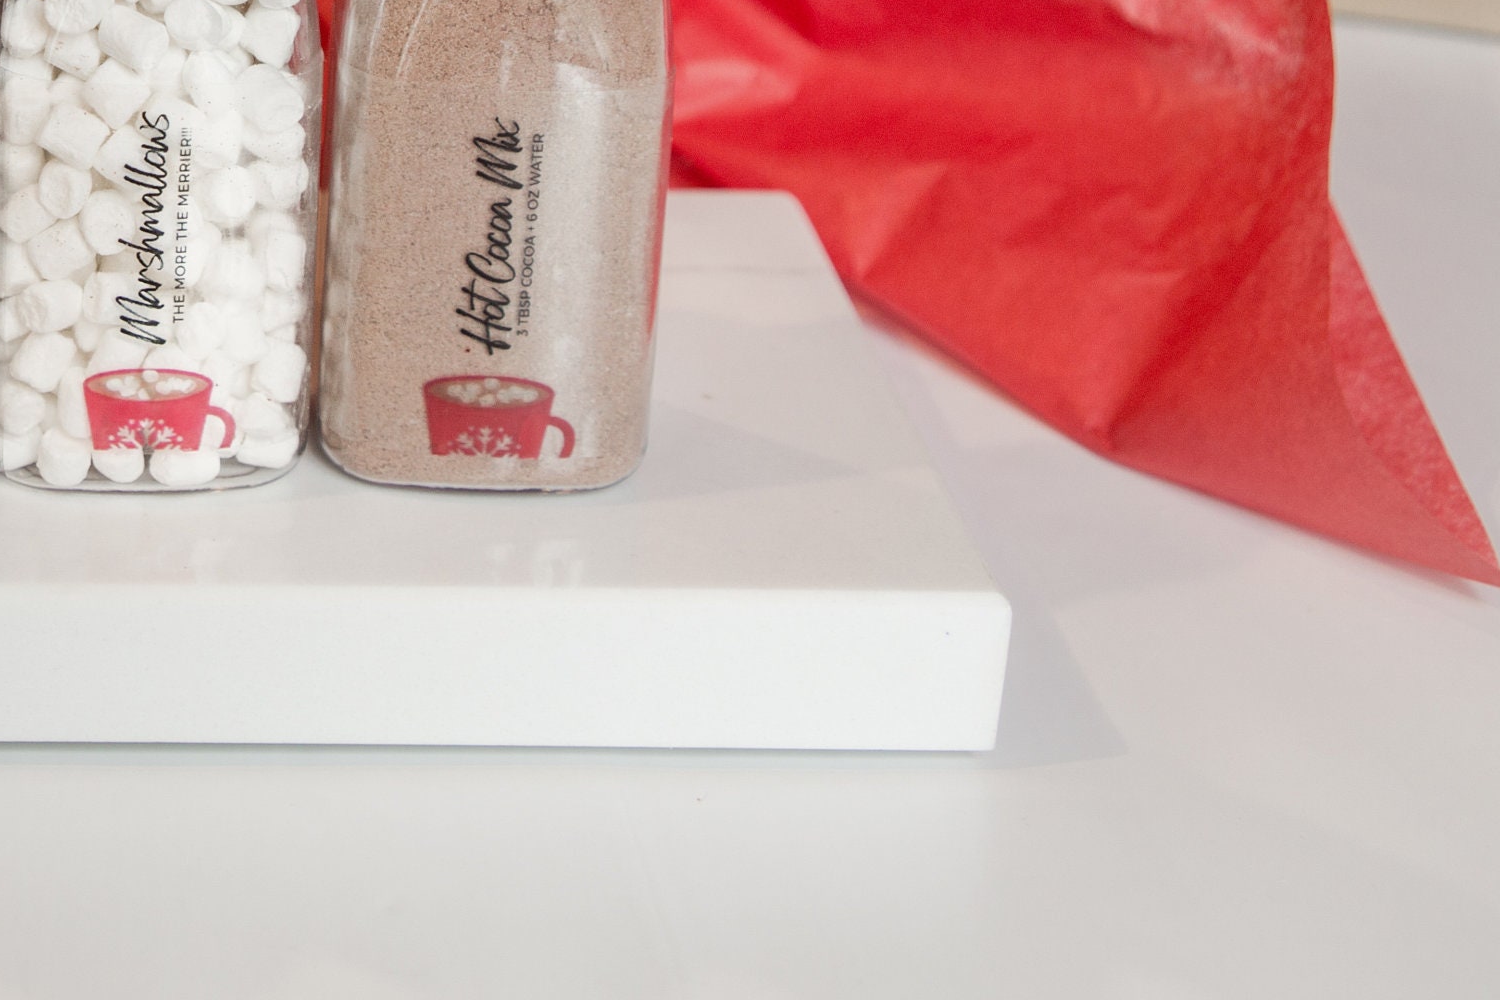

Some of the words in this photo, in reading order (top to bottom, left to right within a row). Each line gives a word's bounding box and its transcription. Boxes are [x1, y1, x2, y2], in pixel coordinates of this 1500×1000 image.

[177, 127, 193, 206] MERRIER!!!
[472, 117, 524, 190] Mix
[529, 133, 545, 186] WATER
[526, 213, 538, 222] 6
[527, 190, 540, 210] OZ
[115, 111, 170, 345] Marshmallows
[176, 211, 189, 241] THE
[465, 198, 516, 284] Cocoa
[174, 246, 187, 290] MORE
[520, 236, 536, 288] COCOA
[172, 295, 186, 324] THE
[456, 278, 512, 356] Hot
[517, 290, 531, 326] TBSP
[516, 329, 529, 337] 3
